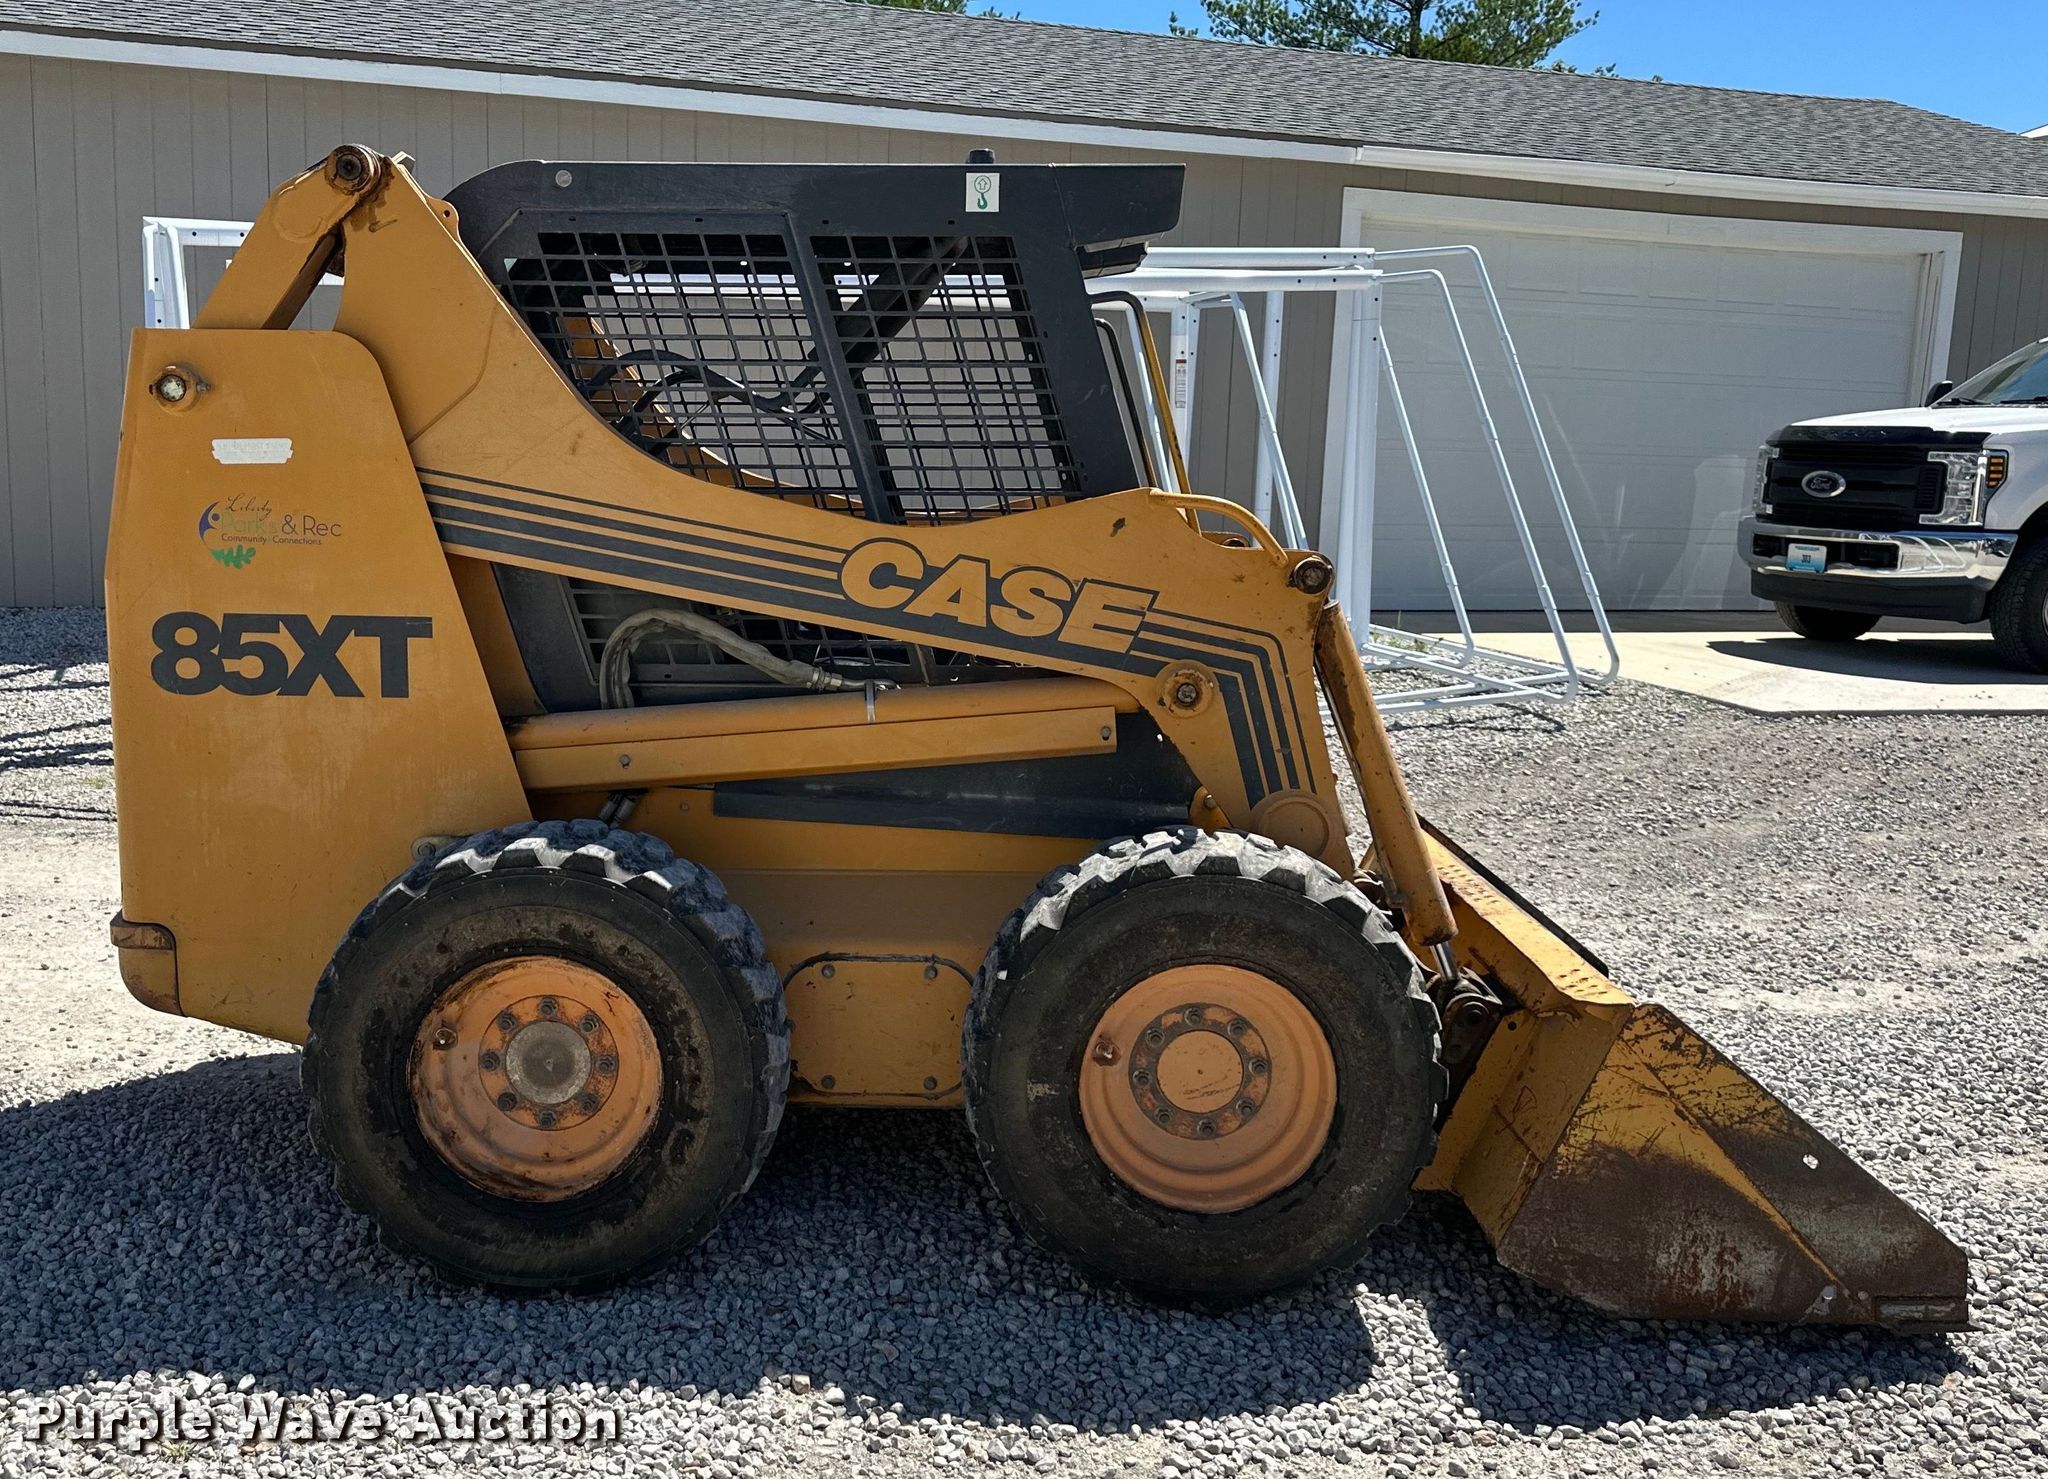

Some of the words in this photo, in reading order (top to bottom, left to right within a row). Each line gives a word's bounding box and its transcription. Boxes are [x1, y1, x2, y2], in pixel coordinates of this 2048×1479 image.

[225, 492, 273, 521] Liberty
[221, 511, 278, 535] Parks
[281, 514, 298, 535] &
[303, 515, 342, 537] Rec
[221, 532, 267, 545] Community
[272, 534, 322, 545] Connections
[840, 537, 1160, 655] CASE
[151, 611, 433, 698] 85XT
